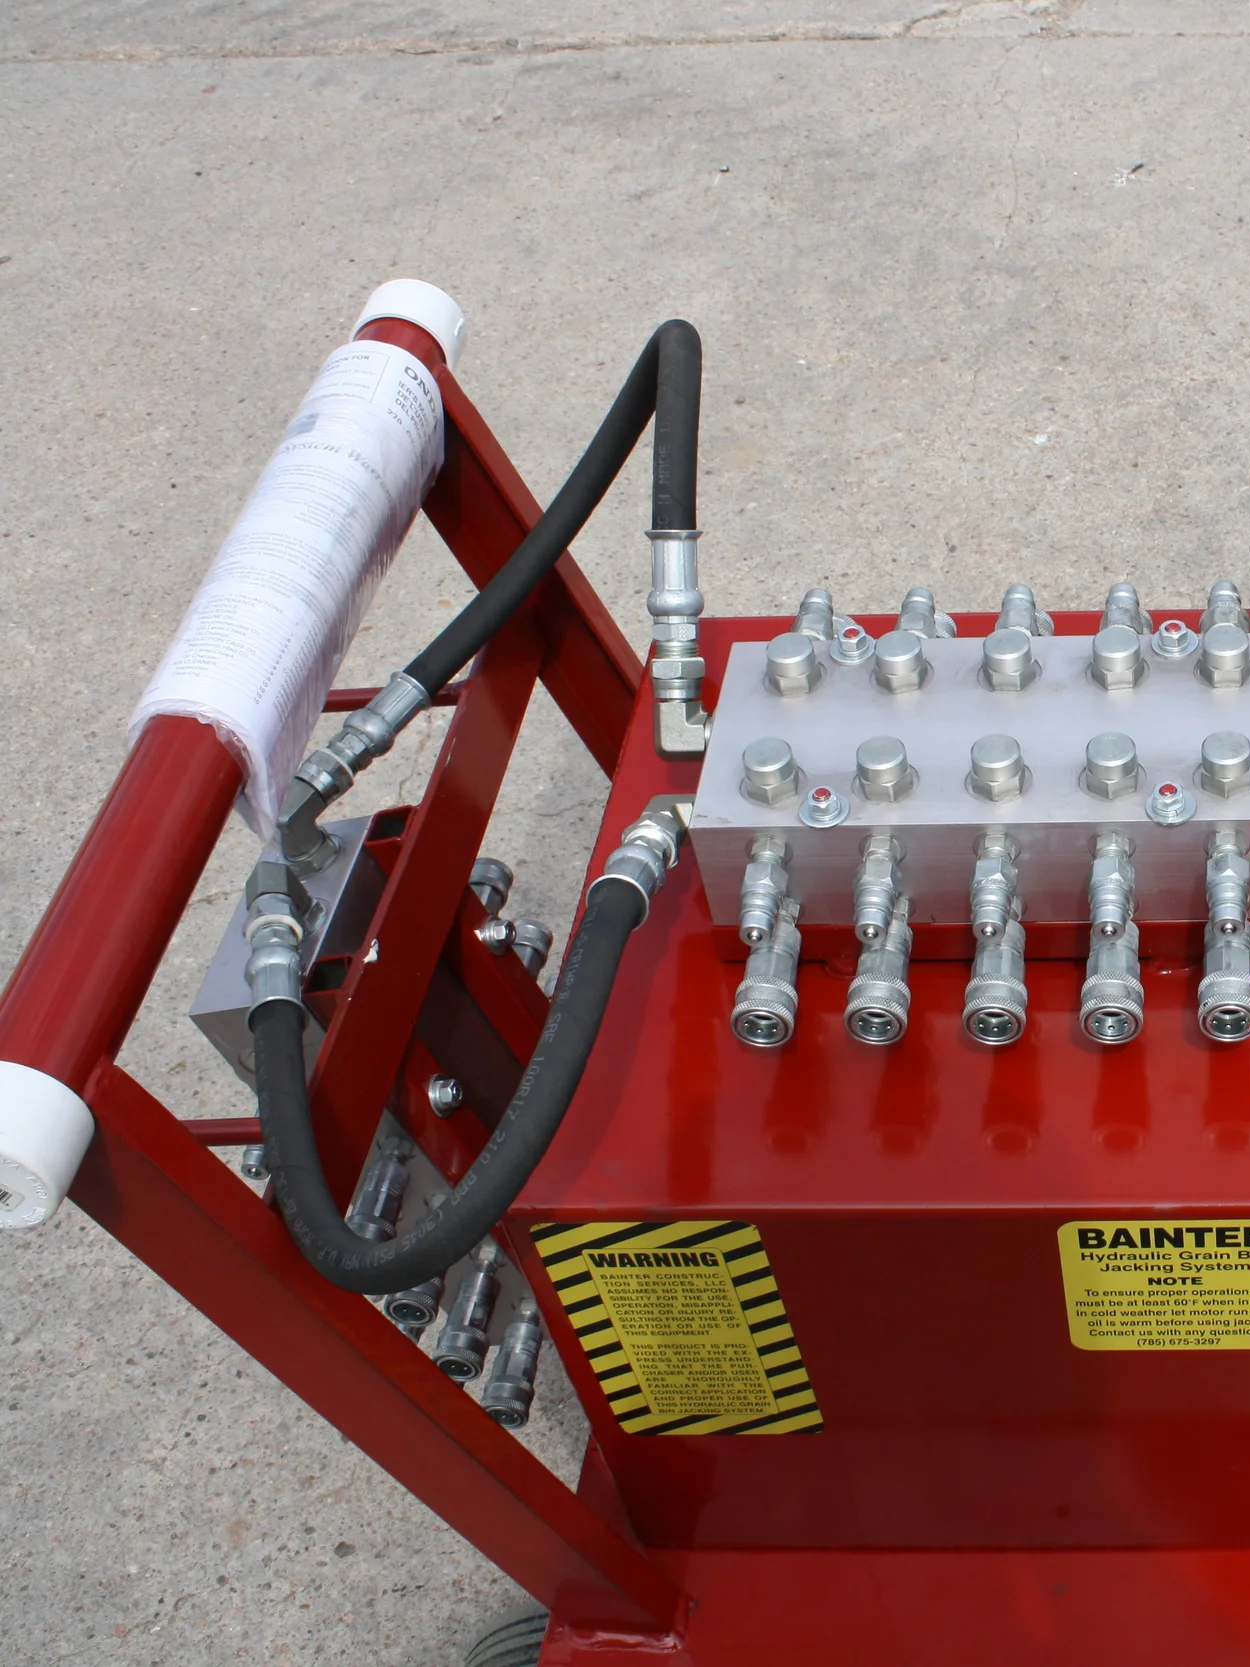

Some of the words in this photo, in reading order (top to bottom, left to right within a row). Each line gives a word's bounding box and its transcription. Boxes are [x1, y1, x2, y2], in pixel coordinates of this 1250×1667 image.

[588, 1252, 720, 1268] WARNING
[1081, 1251, 1172, 1263] Hydraulic
[1179, 1251, 1230, 1261] Grain
[1100, 1263, 1174, 1274] Jacking
[1180, 1262, 1250, 1273] System
[1148, 1277, 1204, 1286] NOTE
[1084, 1289, 1099, 1297] To
[1148, 1289, 1188, 1298] proper
[1191, 1288, 1249, 1297] operation
[1109, 1299, 1124, 1307] be
[1142, 1299, 1171, 1307] least
[1202, 1298, 1235, 1306] when
[1238, 1298, 1249, 1306] in
[1076, 1309, 1088, 1317] In
[1091, 1309, 1117, 1317] cold
[1171, 1308, 1186, 1316] let
[1087, 1319, 1103, 1327] oil
[1106, 1319, 1116, 1327] is
[1197, 1319, 1230, 1327] using
[1089, 1329, 1135, 1337] Contact
[1156, 1328, 1181, 1336] with
[1185, 1329, 1206, 1337] any
[1136, 1337, 1166, 1347] (785)
[1169, 1337, 1221, 1346] 675-3297
